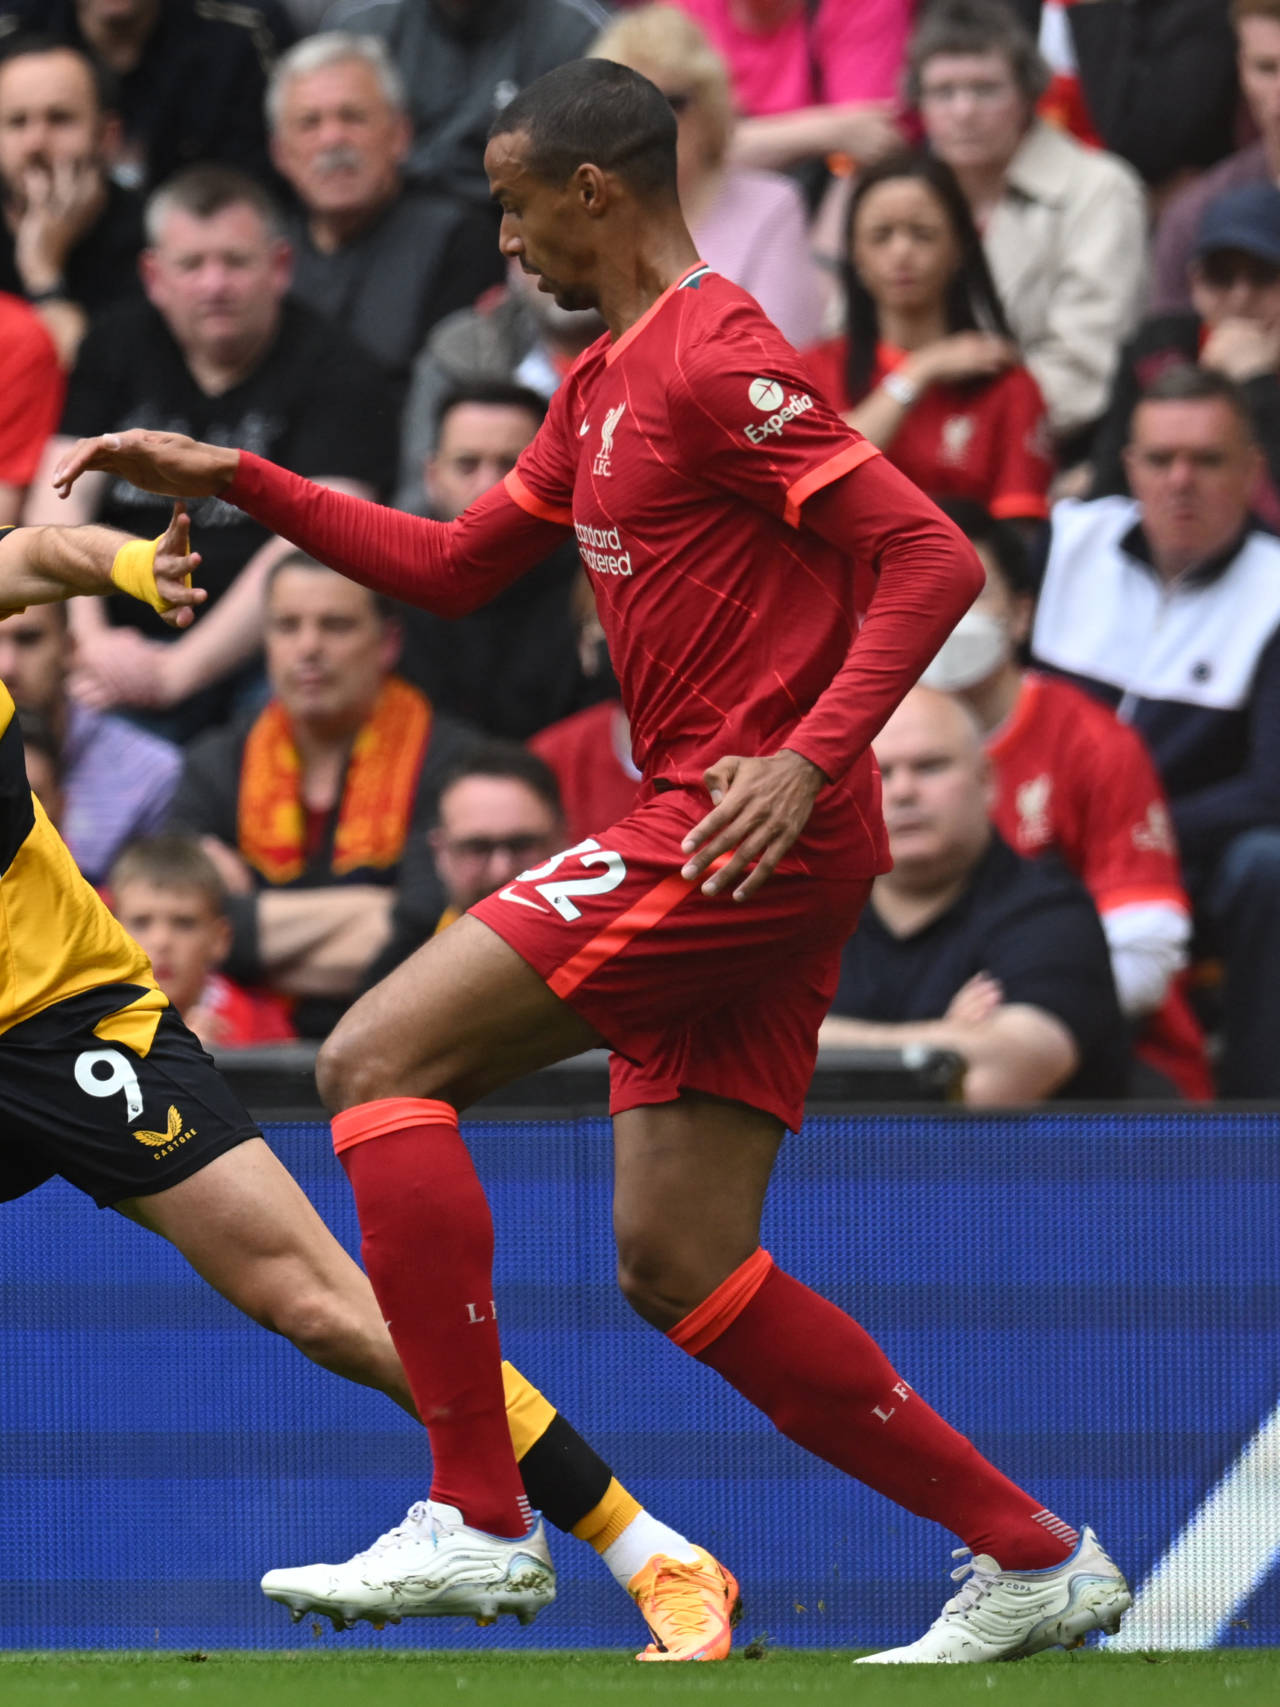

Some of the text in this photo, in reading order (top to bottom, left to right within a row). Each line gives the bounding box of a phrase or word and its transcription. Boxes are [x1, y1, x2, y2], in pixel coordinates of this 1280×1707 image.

[744, 393, 814, 444] Expedia
[593, 458, 612, 477] LFC
[74, 1048, 144, 1123] 9
[153, 1128, 198, 1160] CASTORE
[1005, 1582, 1033, 1593] COPA
